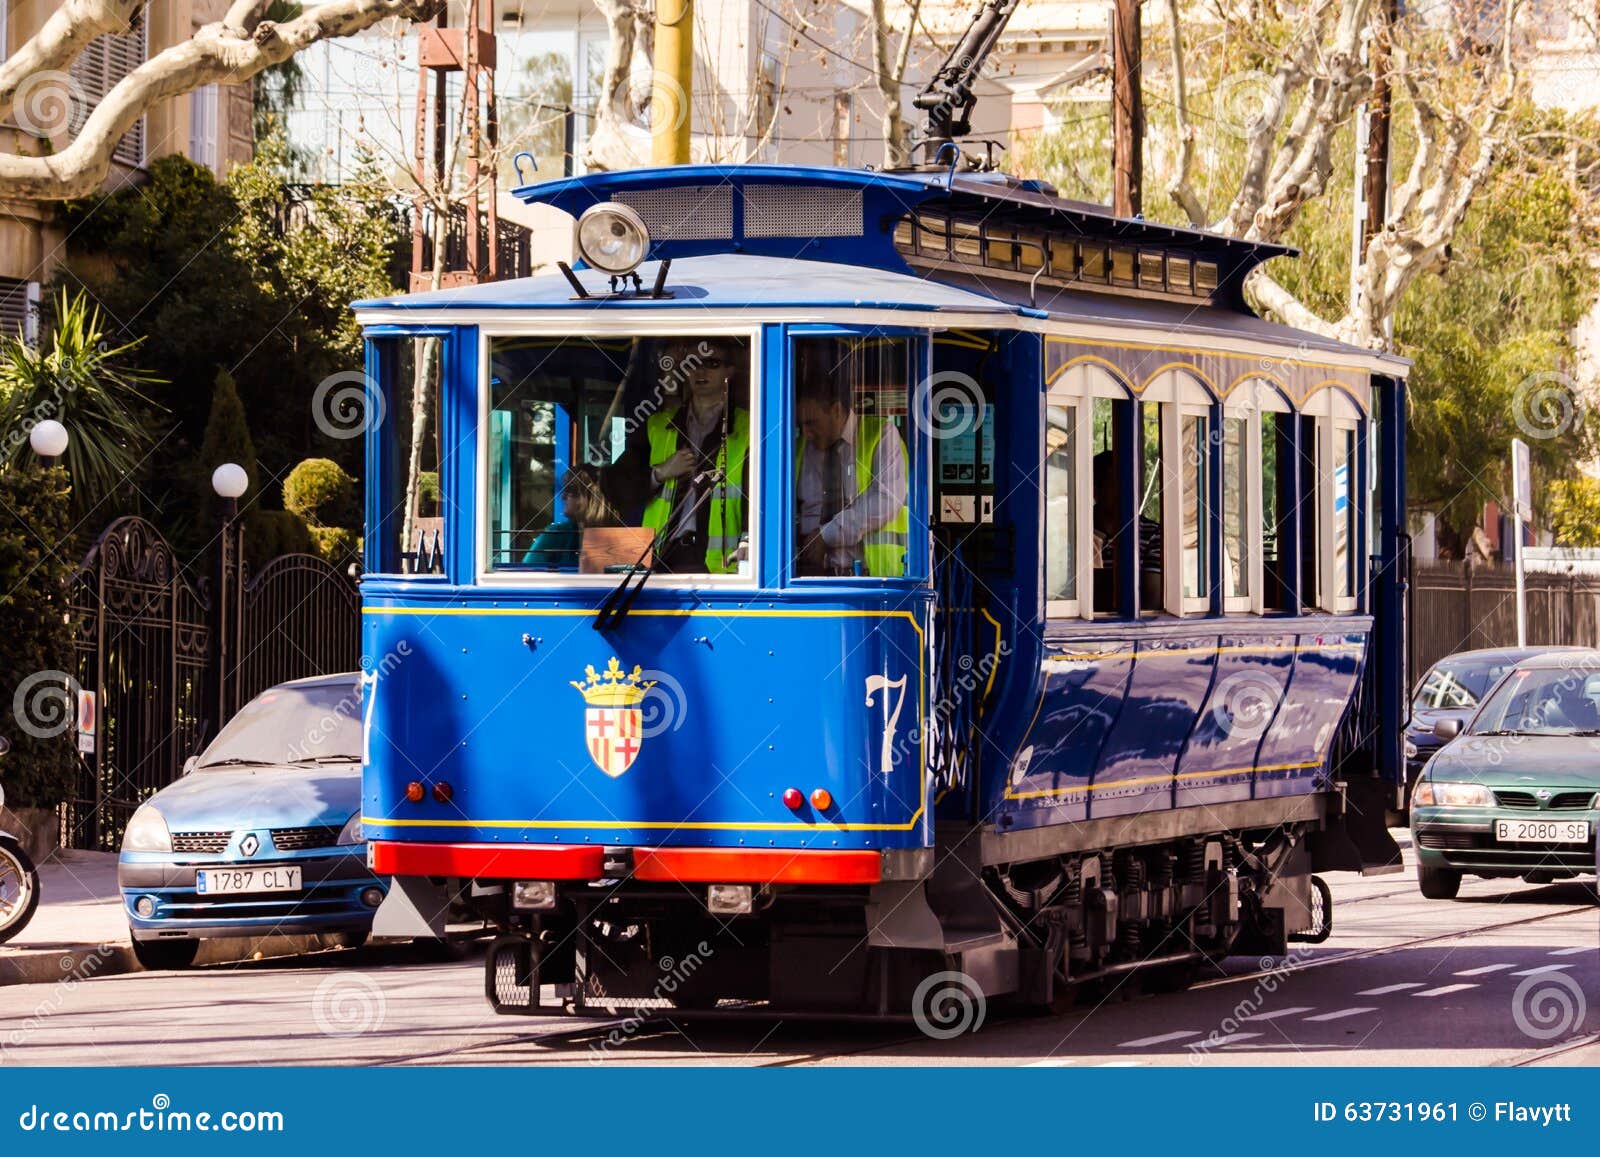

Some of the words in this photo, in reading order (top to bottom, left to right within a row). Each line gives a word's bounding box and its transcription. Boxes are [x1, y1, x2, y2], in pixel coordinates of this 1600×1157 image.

[865, 673, 908, 772] 7
[1518, 823, 1557, 839] 2080
[1567, 824, 1586, 840] SB
[213, 871, 254, 891] 1787
[263, 870, 295, 888] CLY
